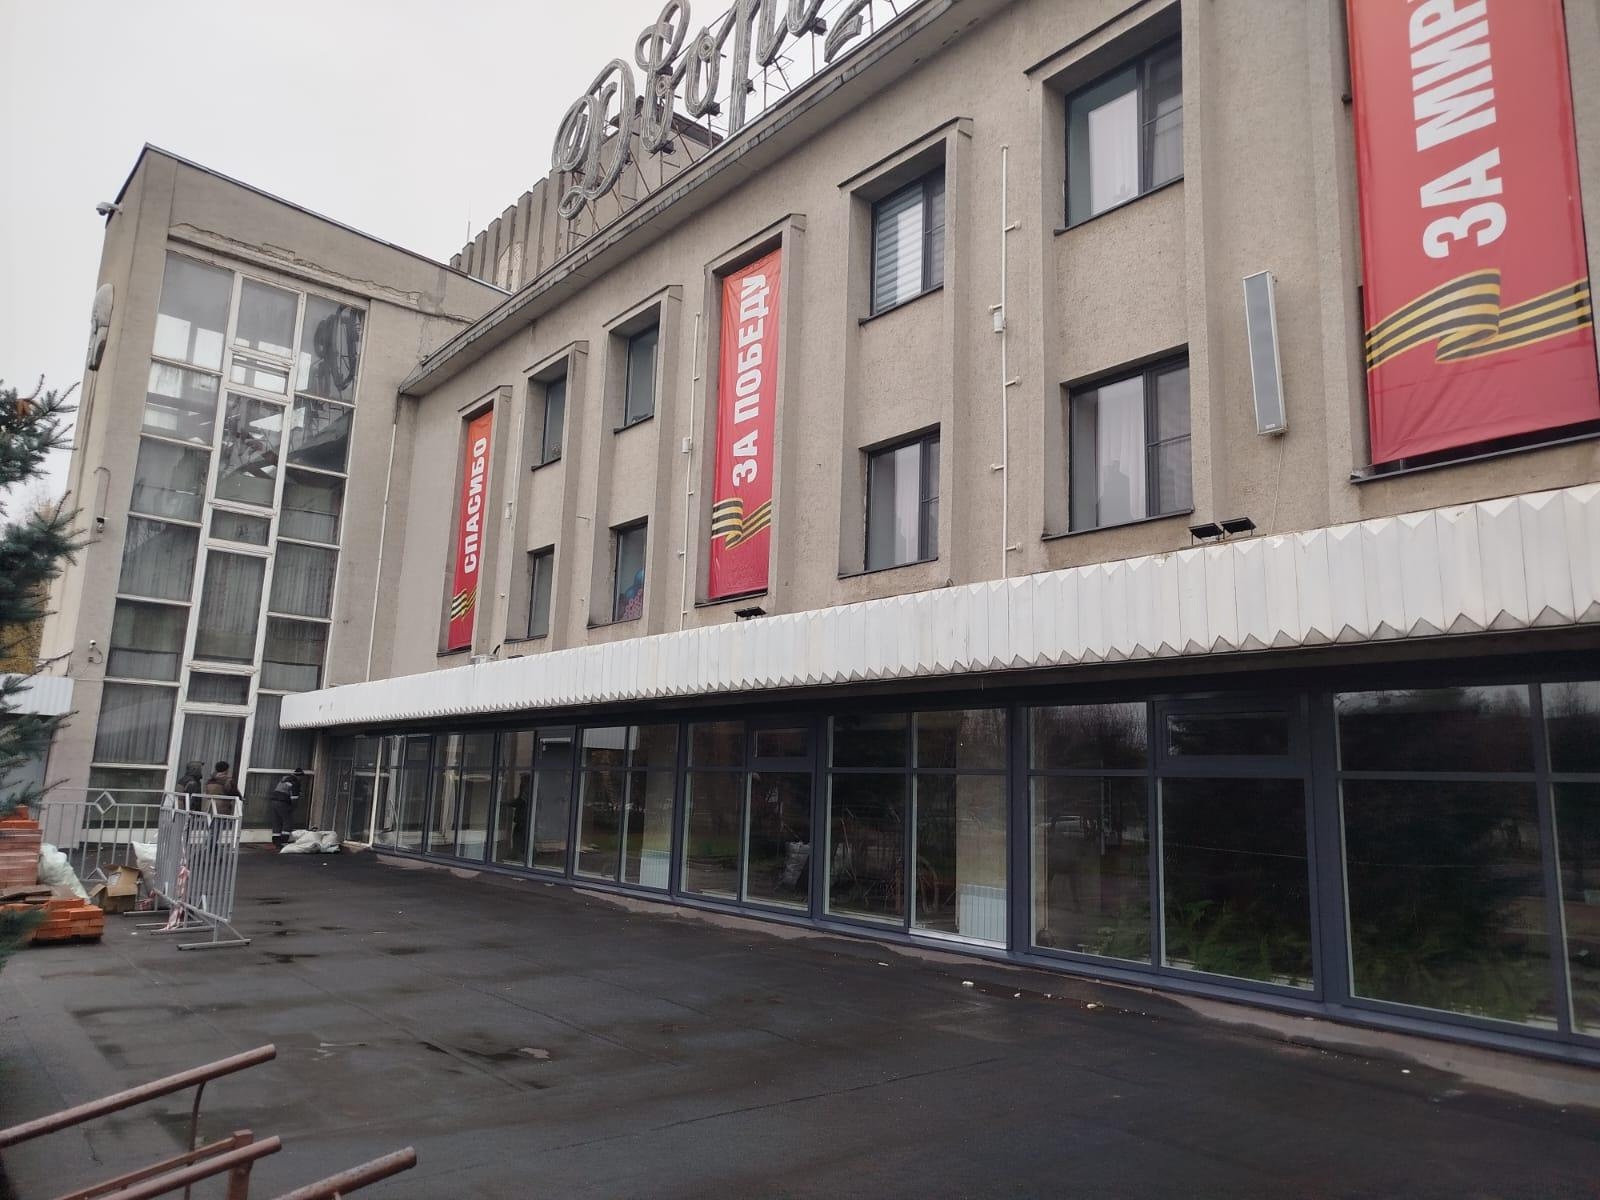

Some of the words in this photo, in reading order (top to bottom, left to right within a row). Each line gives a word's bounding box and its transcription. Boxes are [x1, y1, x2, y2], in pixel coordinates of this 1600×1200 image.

[1408, 0, 1497, 152] МИР
[1420, 147, 1507, 259] ЗА
[734, 273, 770, 424] ПОБЕДУ
[464, 437, 488, 575] СПАСИБО
[732, 429, 759, 487] ЗА
